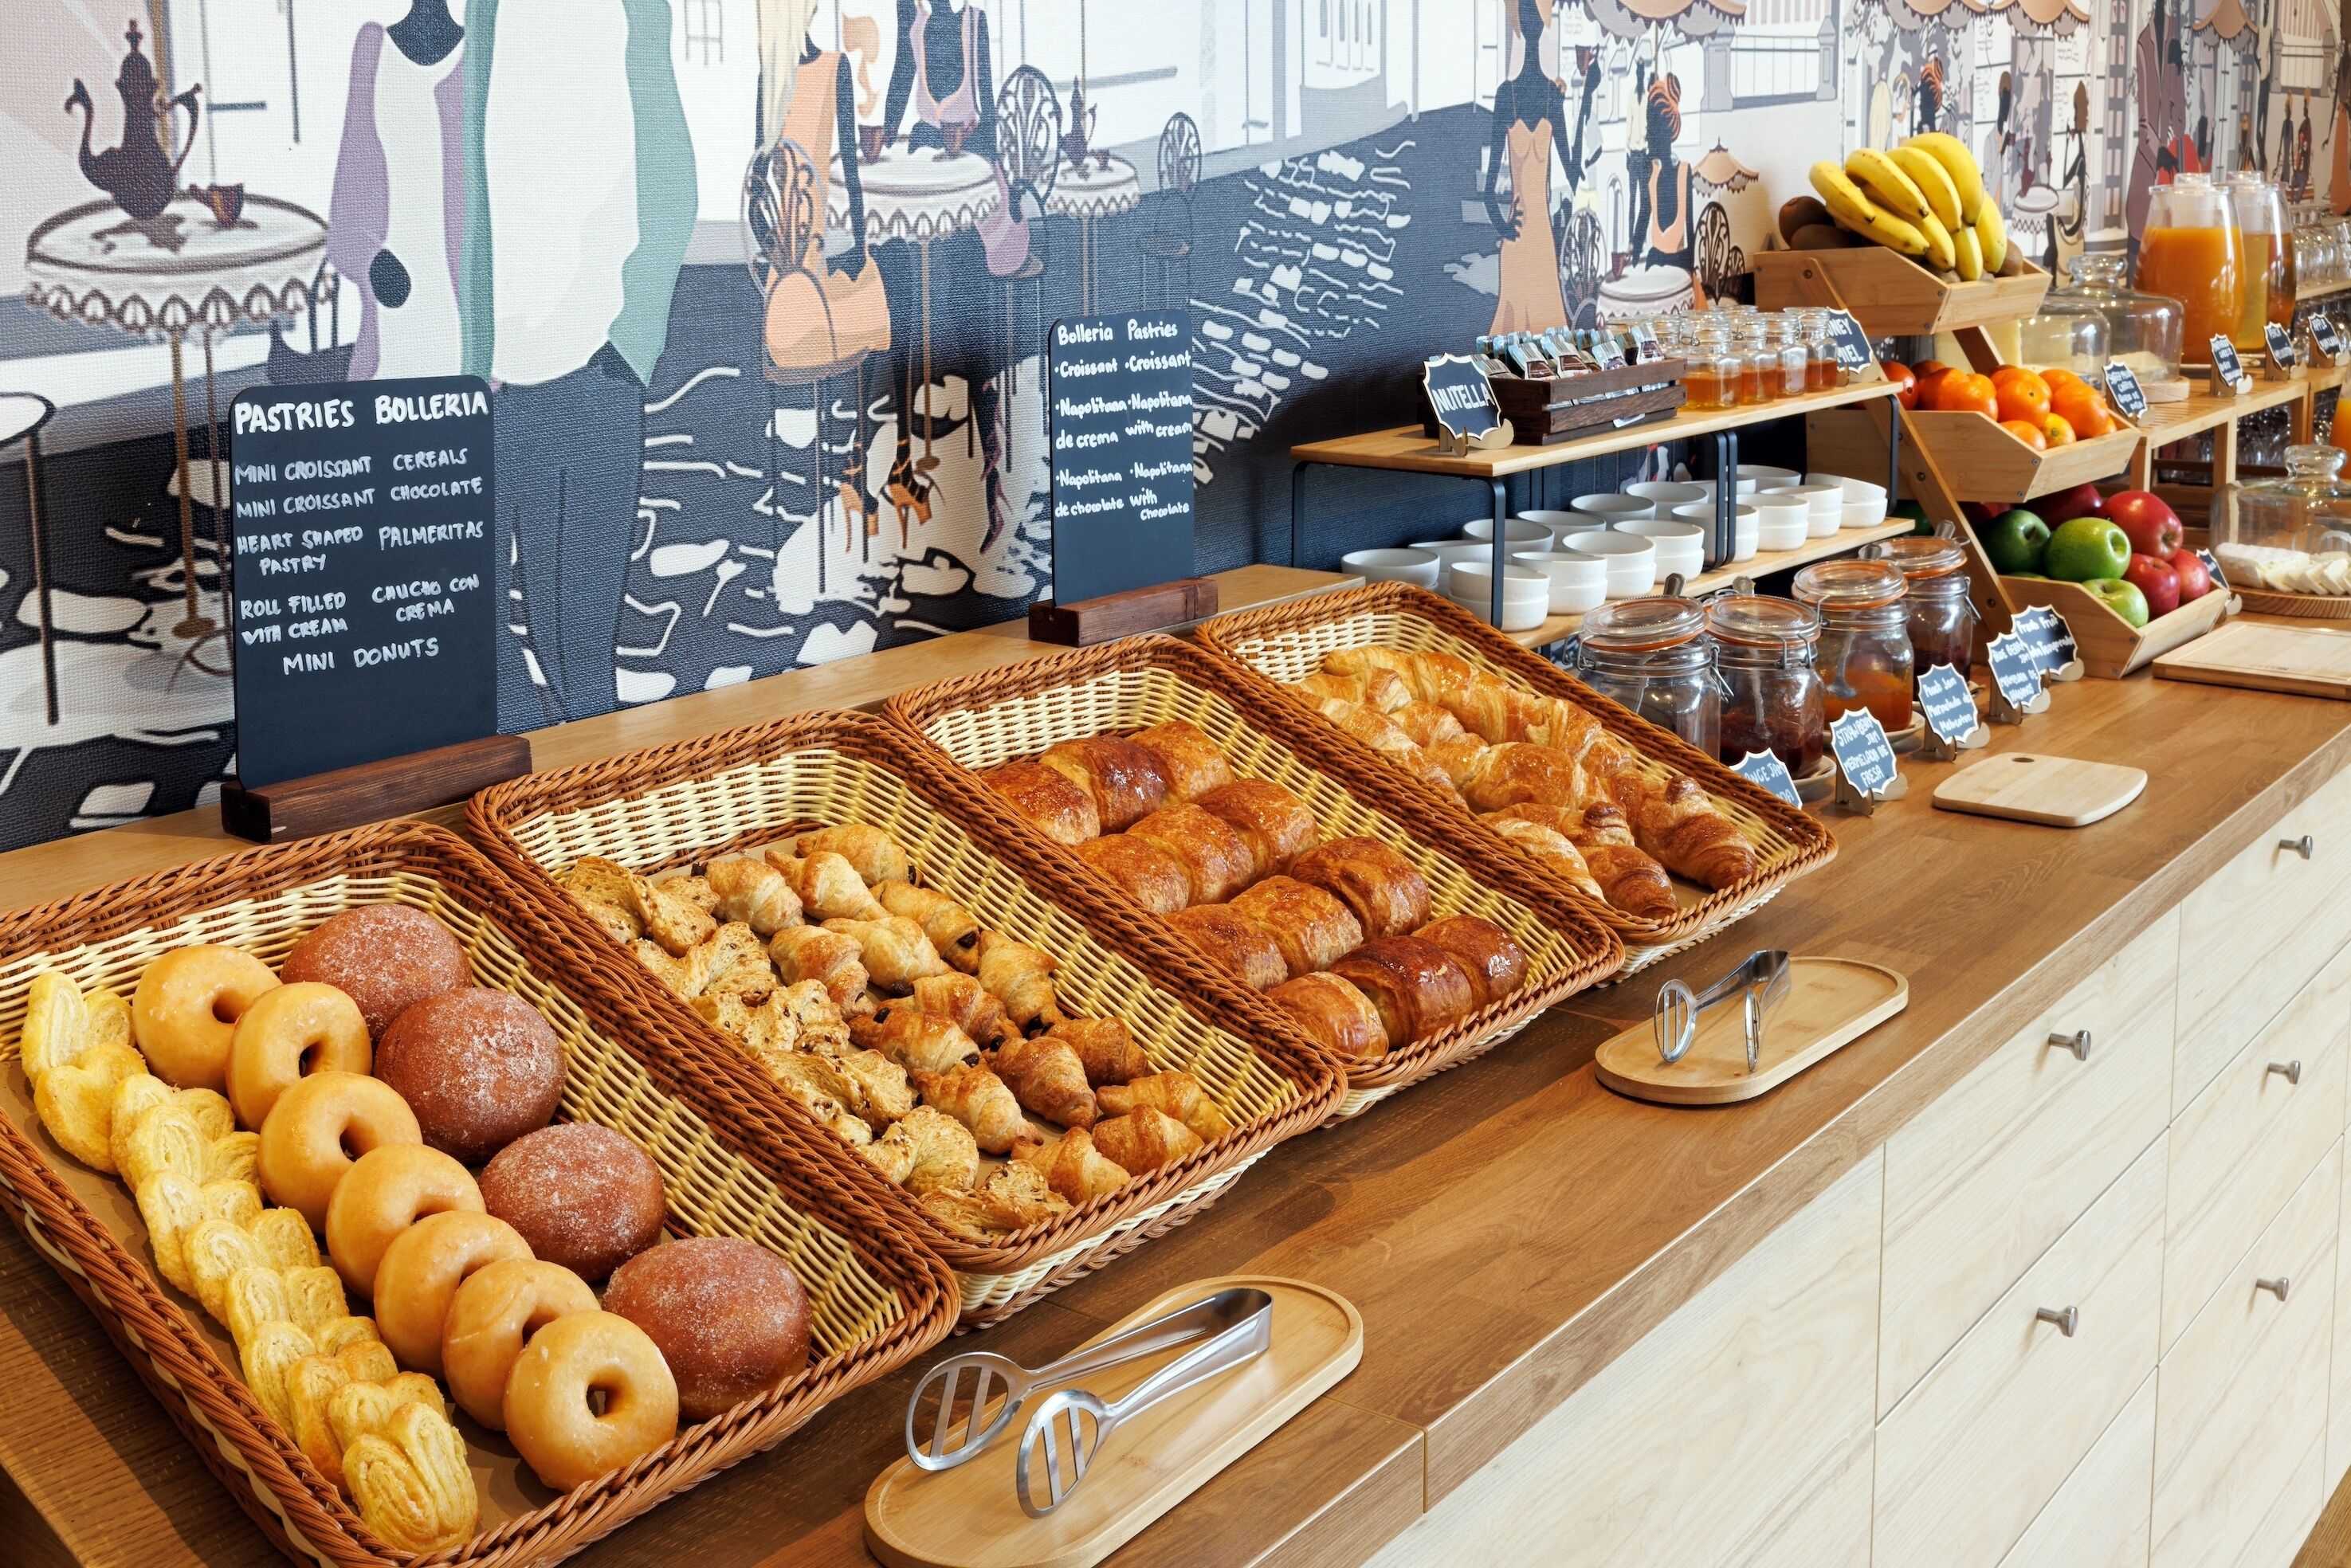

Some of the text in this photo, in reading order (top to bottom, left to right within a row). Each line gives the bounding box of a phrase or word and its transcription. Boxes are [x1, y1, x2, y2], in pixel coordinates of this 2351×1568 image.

[1058, 319, 1178, 346] Bolleria Pastries
[1060, 358, 1117, 378] Croissant
[1129, 350, 1191, 372] Croissant
[1060, 396, 1128, 420] Napolitana
[1132, 390, 1193, 413] Napolitana
[1431, 382, 1496, 414] NUTELLA
[234, 391, 489, 434] PASTRIES BOLLERIA
[1056, 429, 1119, 450] de crema
[1124, 419, 1193, 438] with cream
[235, 447, 469, 486] MINI CROISSANT CEREALS
[1134, 461, 1193, 480] Napolitana
[1059, 468, 1123, 490] Napolitana
[236, 476, 483, 518] MINI CROISSANT CHOCOLATE
[1054, 496, 1124, 518] de chocolate
[1129, 487, 1158, 508] with
[236, 526, 364, 555] HEART SHAPED
[379, 520, 484, 551] PALMERITAS
[259, 553, 327, 576] PASTRY
[449, 573, 480, 592] CON
[240, 591, 347, 620] ROLL FILLED
[395, 598, 455, 622] CREMA
[288, 617, 348, 638] CREAM
[283, 637, 440, 676] MINI DONUTS
[1835, 715, 1874, 747] STRAWBERRY
[1865, 730, 1881, 746] JAM
[1860, 764, 1885, 787] FRESA
